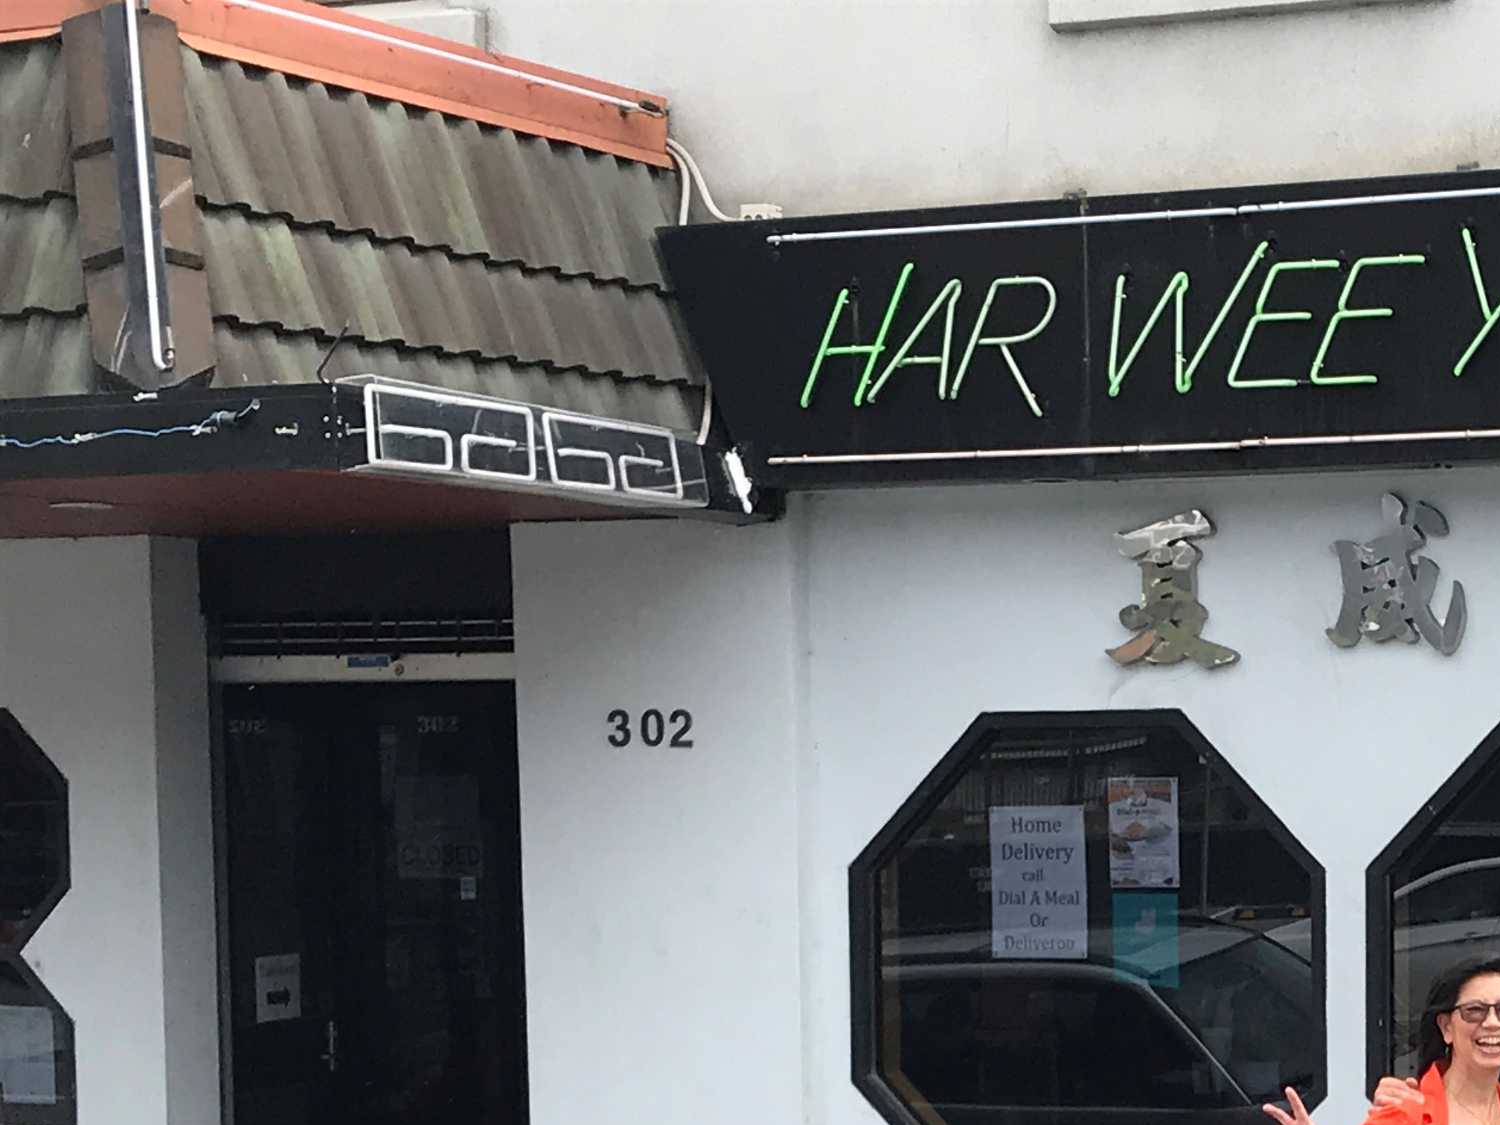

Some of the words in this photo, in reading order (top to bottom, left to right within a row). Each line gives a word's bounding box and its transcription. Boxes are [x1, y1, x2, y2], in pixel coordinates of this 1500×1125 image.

[801, 263, 1057, 417] HAR
[1107, 240, 1426, 397] WEE
[606, 707, 694, 749] 302
[1010, 817, 1062, 834] Home
[1001, 842, 1074, 865] Delivery
[1021, 868, 1044, 882] call
[998, 889, 1026, 906] Dial
[1029, 889, 1044, 906] A
[1045, 888, 1080, 906] Meal
[1029, 912, 1049, 928] Or
